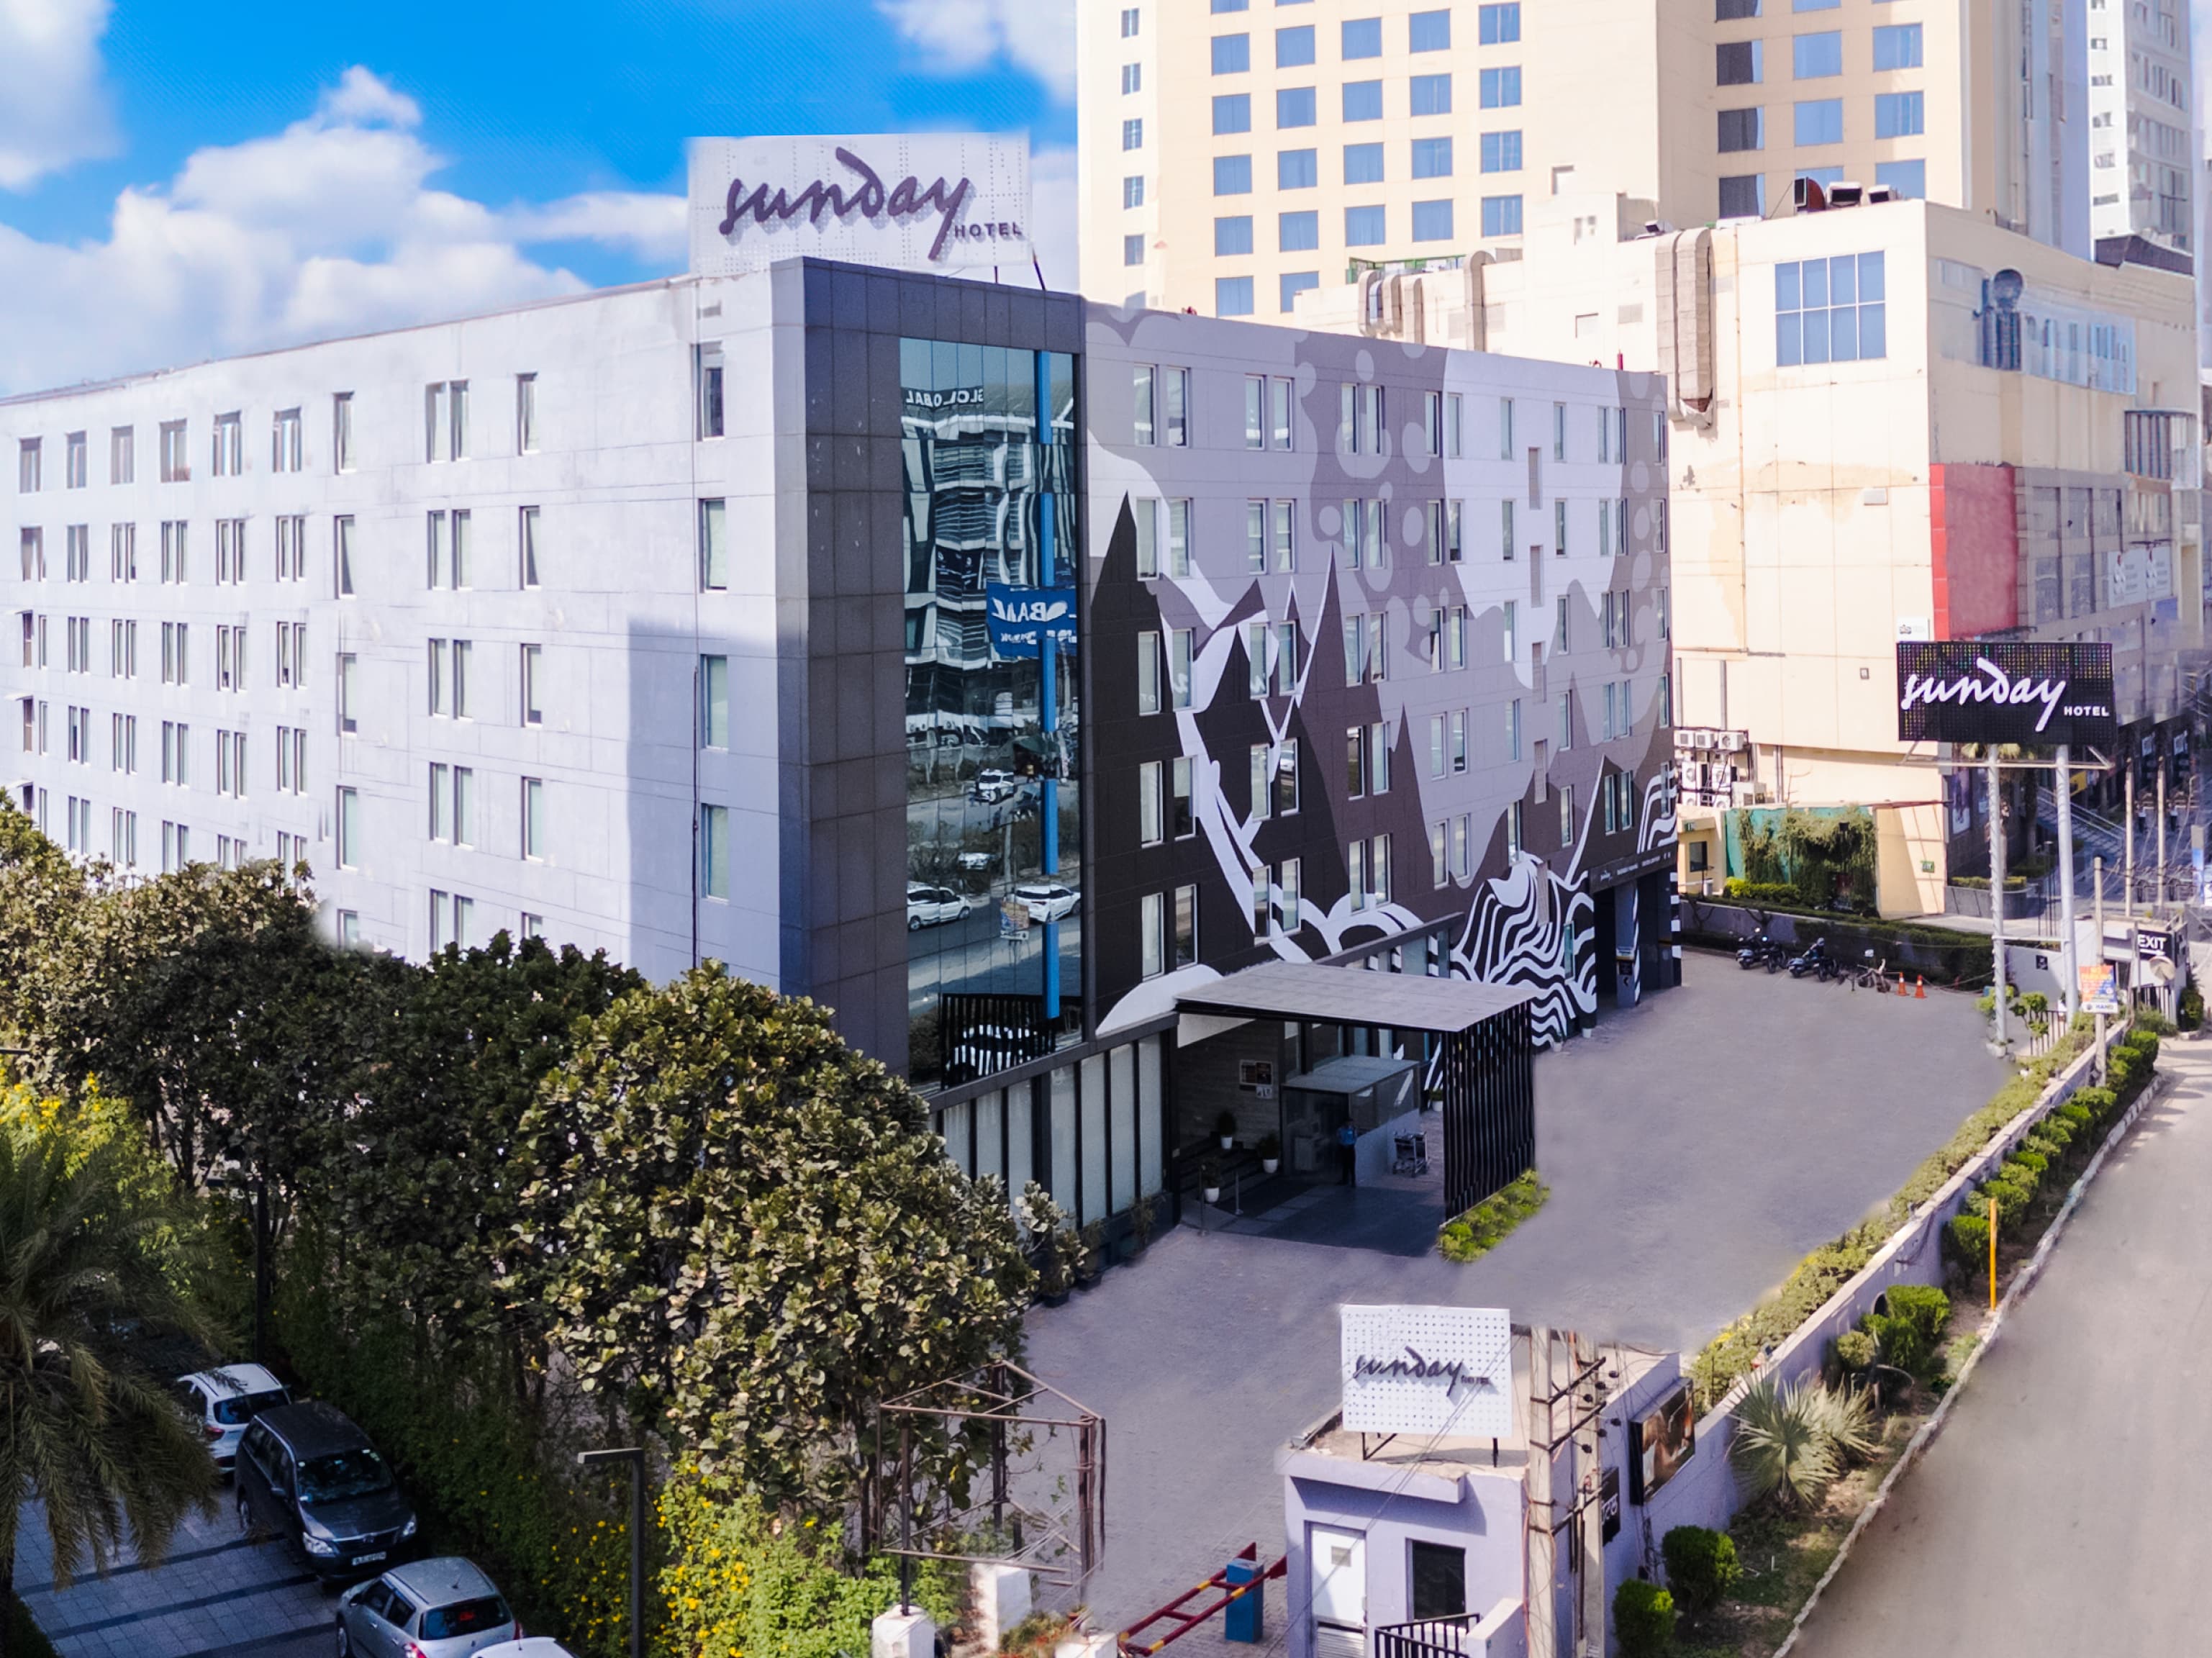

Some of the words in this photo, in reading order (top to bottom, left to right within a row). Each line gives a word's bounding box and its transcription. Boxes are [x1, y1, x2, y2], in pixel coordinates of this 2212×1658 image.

[719, 146, 969, 261] sunday
[953, 222, 1023, 239] HOTEL
[1900, 657, 2066, 732] sunday
[2064, 706, 2109, 717] HOTEL
[2138, 935, 2167, 950] EXIT
